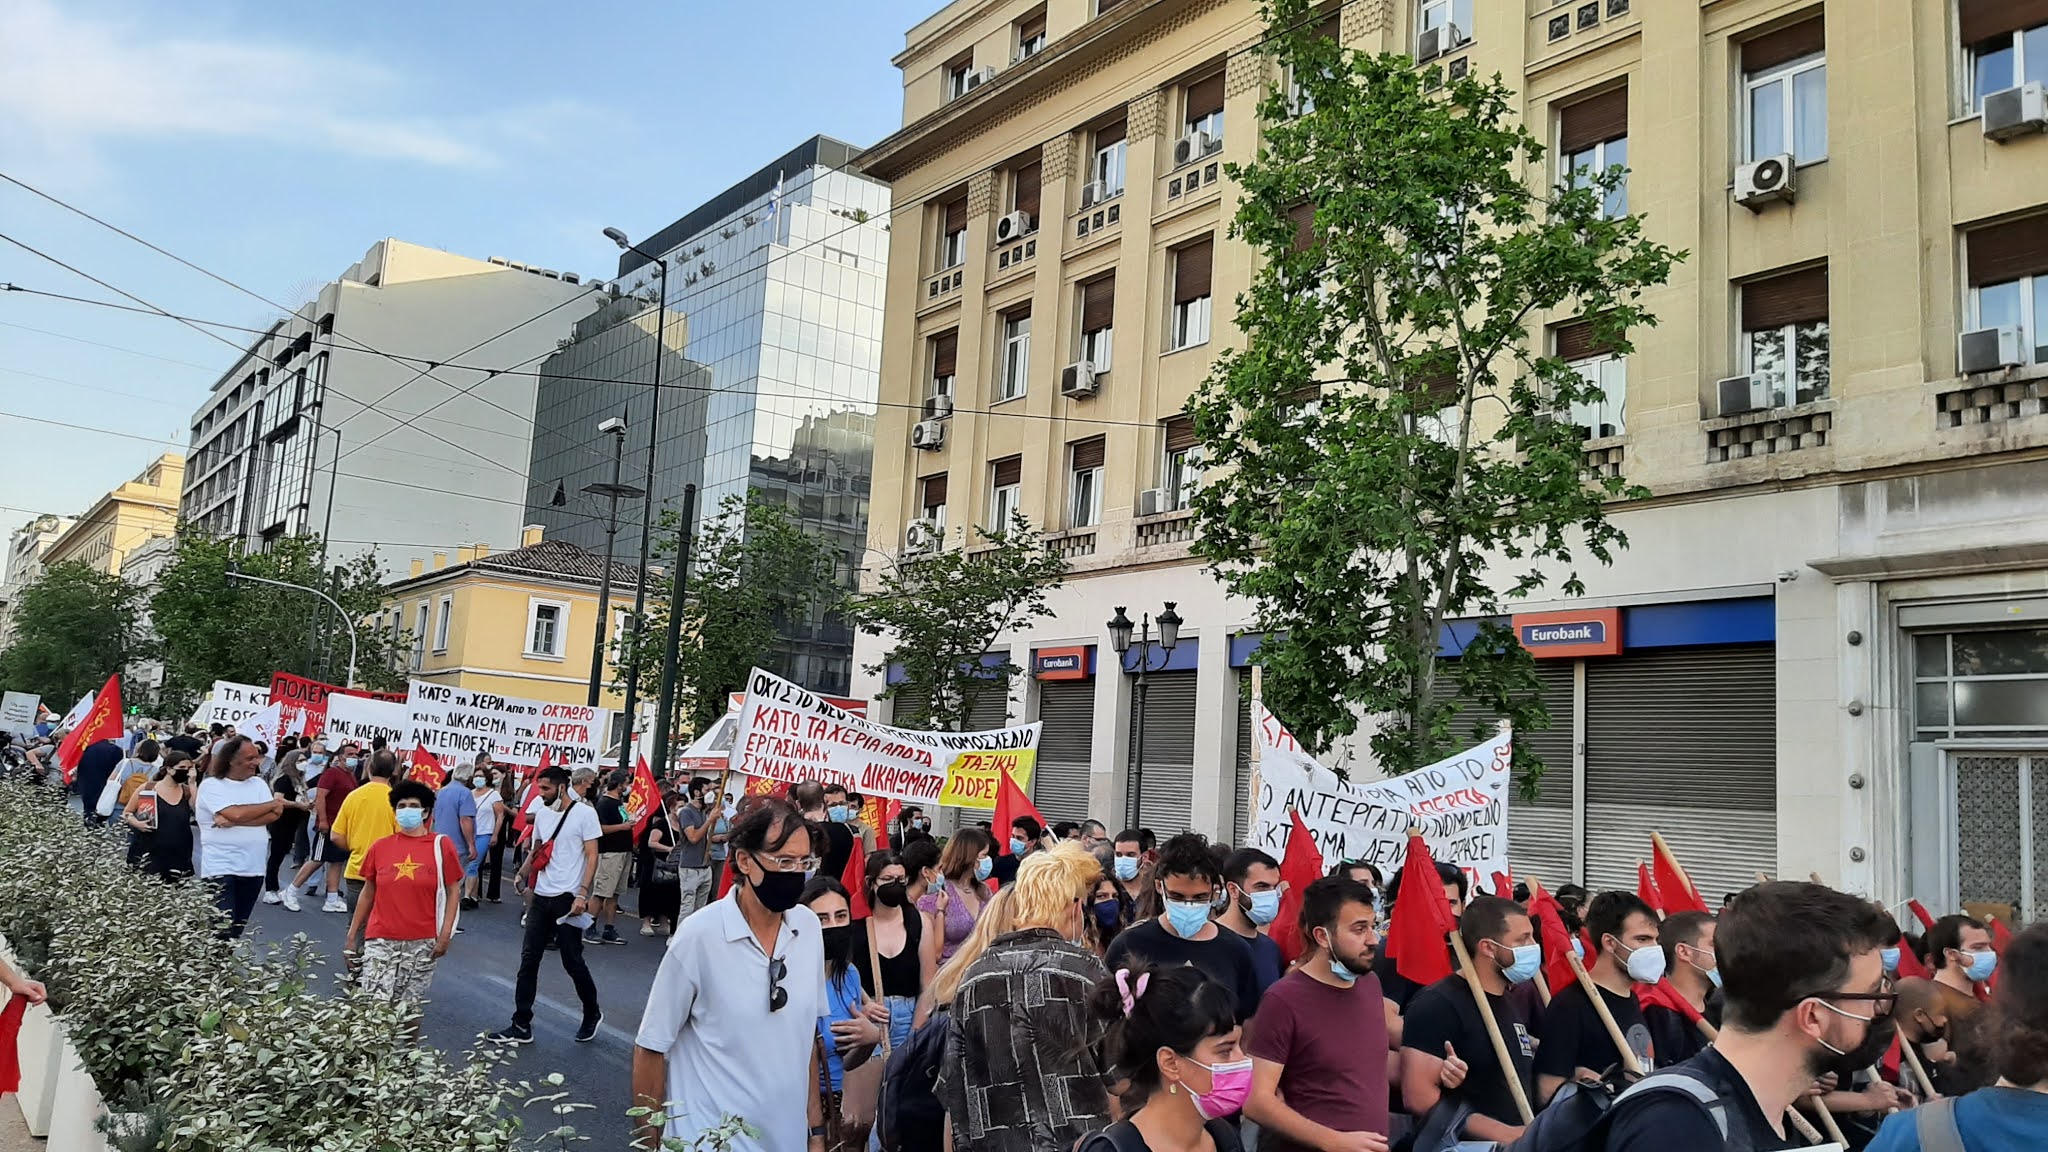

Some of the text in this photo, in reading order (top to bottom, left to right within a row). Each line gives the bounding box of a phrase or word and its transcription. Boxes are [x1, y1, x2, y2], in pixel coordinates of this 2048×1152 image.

[1531, 626, 1591, 641] Eurobank
[1043, 658, 1073, 668] Eurobank
[224, 687, 270, 706] ΤΑ ΚΤ
[274, 677, 346, 705] ΠΟΛΕΜ
[418, 684, 452, 704] ΚΑΤΩ
[470, 692, 505, 712] ΧΕΡΙΑ
[527, 706, 538, 716] ΤΟ
[542, 704, 595, 721] ΟΚΤΑΩΡΟ
[212, 707, 227, 721] ΣΕ
[753, 675, 781, 700] ΟΧΙ
[779, 685, 813, 708] ΣΤΟ
[941, 728, 1033, 751] ΝΟΜΟΣΧΕΔΙΟ
[330, 717, 351, 736] ΜΑΣ
[354, 722, 403, 743] ΚΛΕΒΟΥΝ
[411, 727, 496, 754] ΑΝΤΕΠΙΘΕΣΗ
[446, 712, 507, 735] ΔΙΚΑΙΩΜΑ
[537, 722, 589, 744] ΑΠΕΡΓΙΑ
[753, 704, 934, 768] ΚΑΤΩ ΤΑ ΧΕΡΙΑ ΑΠΟ ΤΑ
[746, 732, 820, 762] ΕΡΓΑΣΙΑΚΑ
[960, 755, 1018, 771] ΤΑΞΙΚΗ
[861, 762, 945, 799] ΔΙΚΑΙΩΜΑΤΑ
[951, 775, 1001, 800] ΠΟΡΕΙ
[1404, 770, 1446, 797] ΑΠΟ
[1448, 758, 1485, 782] ΤΟ
[1409, 786, 1491, 817] ΑΠΕΡΓΙΑ
[1361, 838, 1408, 864] ΔΕΝ
